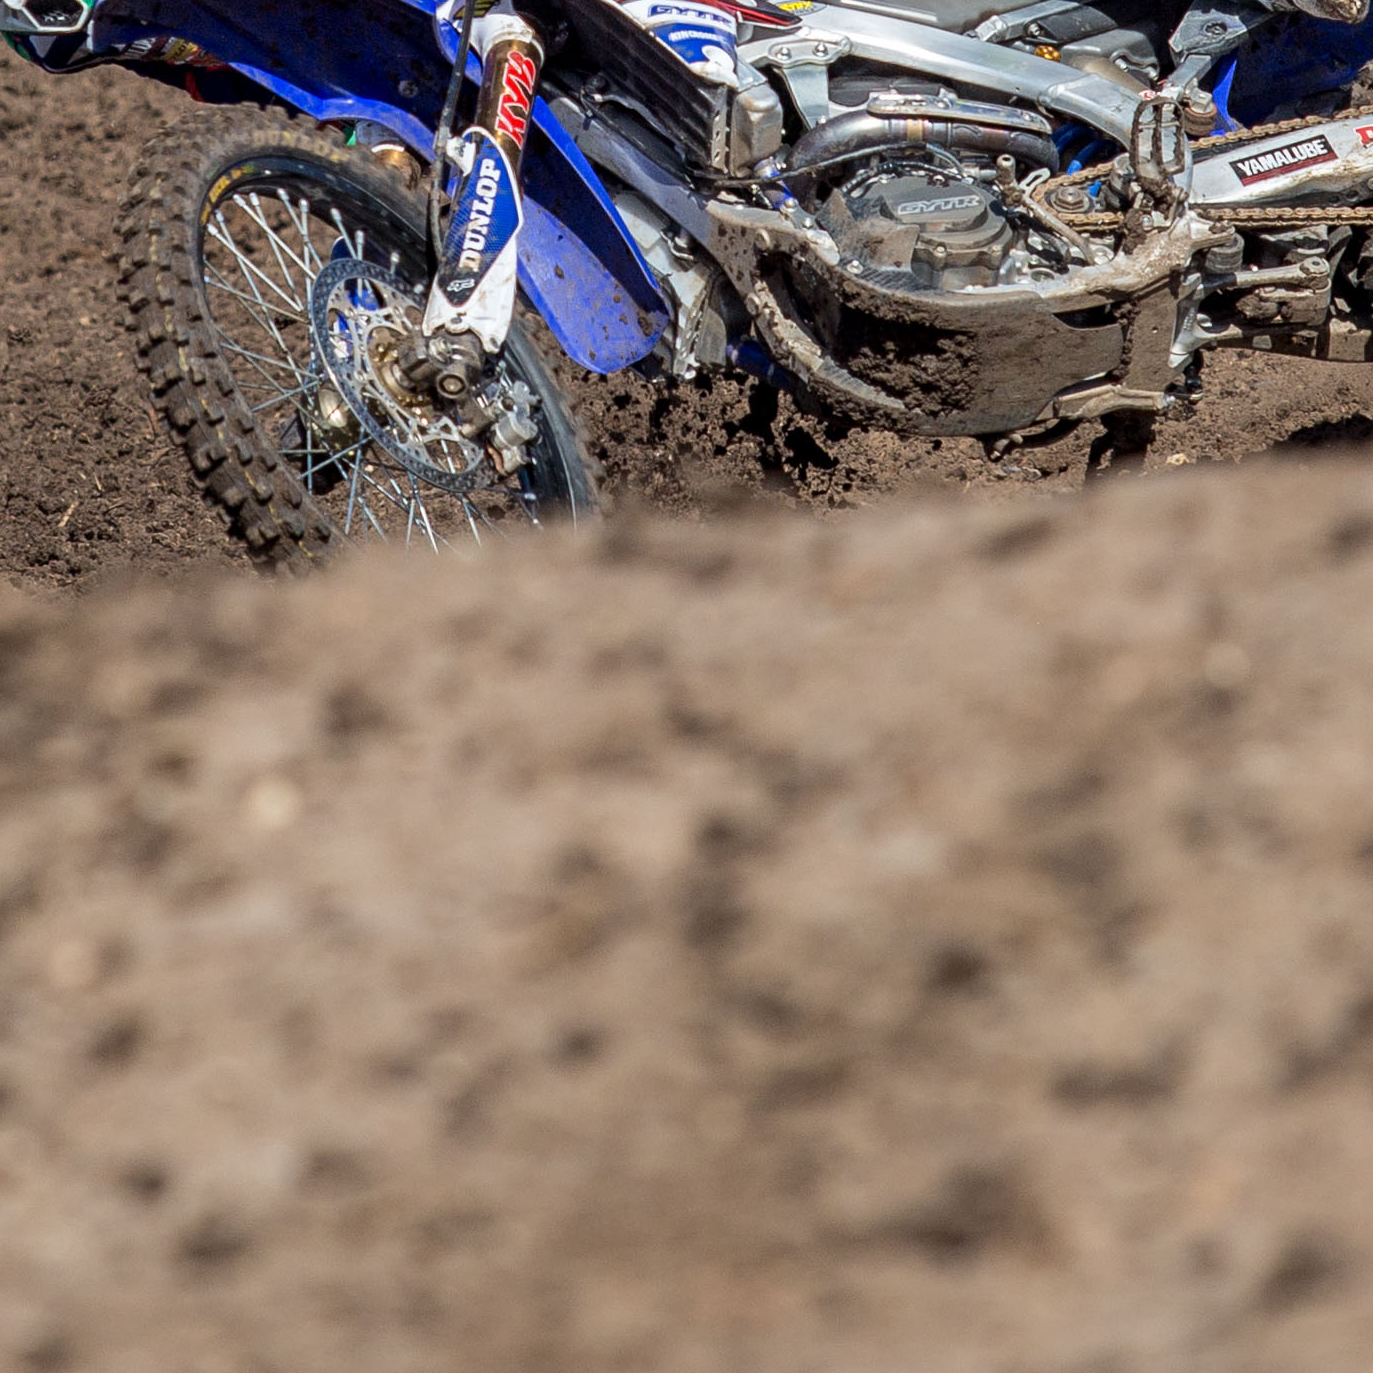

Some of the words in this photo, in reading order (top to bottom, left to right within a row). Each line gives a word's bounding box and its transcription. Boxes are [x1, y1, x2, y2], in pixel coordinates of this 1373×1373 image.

[494, 49, 539, 146] KYB
[1236, 139, 1329, 177] YAMALUBE
[456, 157, 502, 273] DUNLOP
